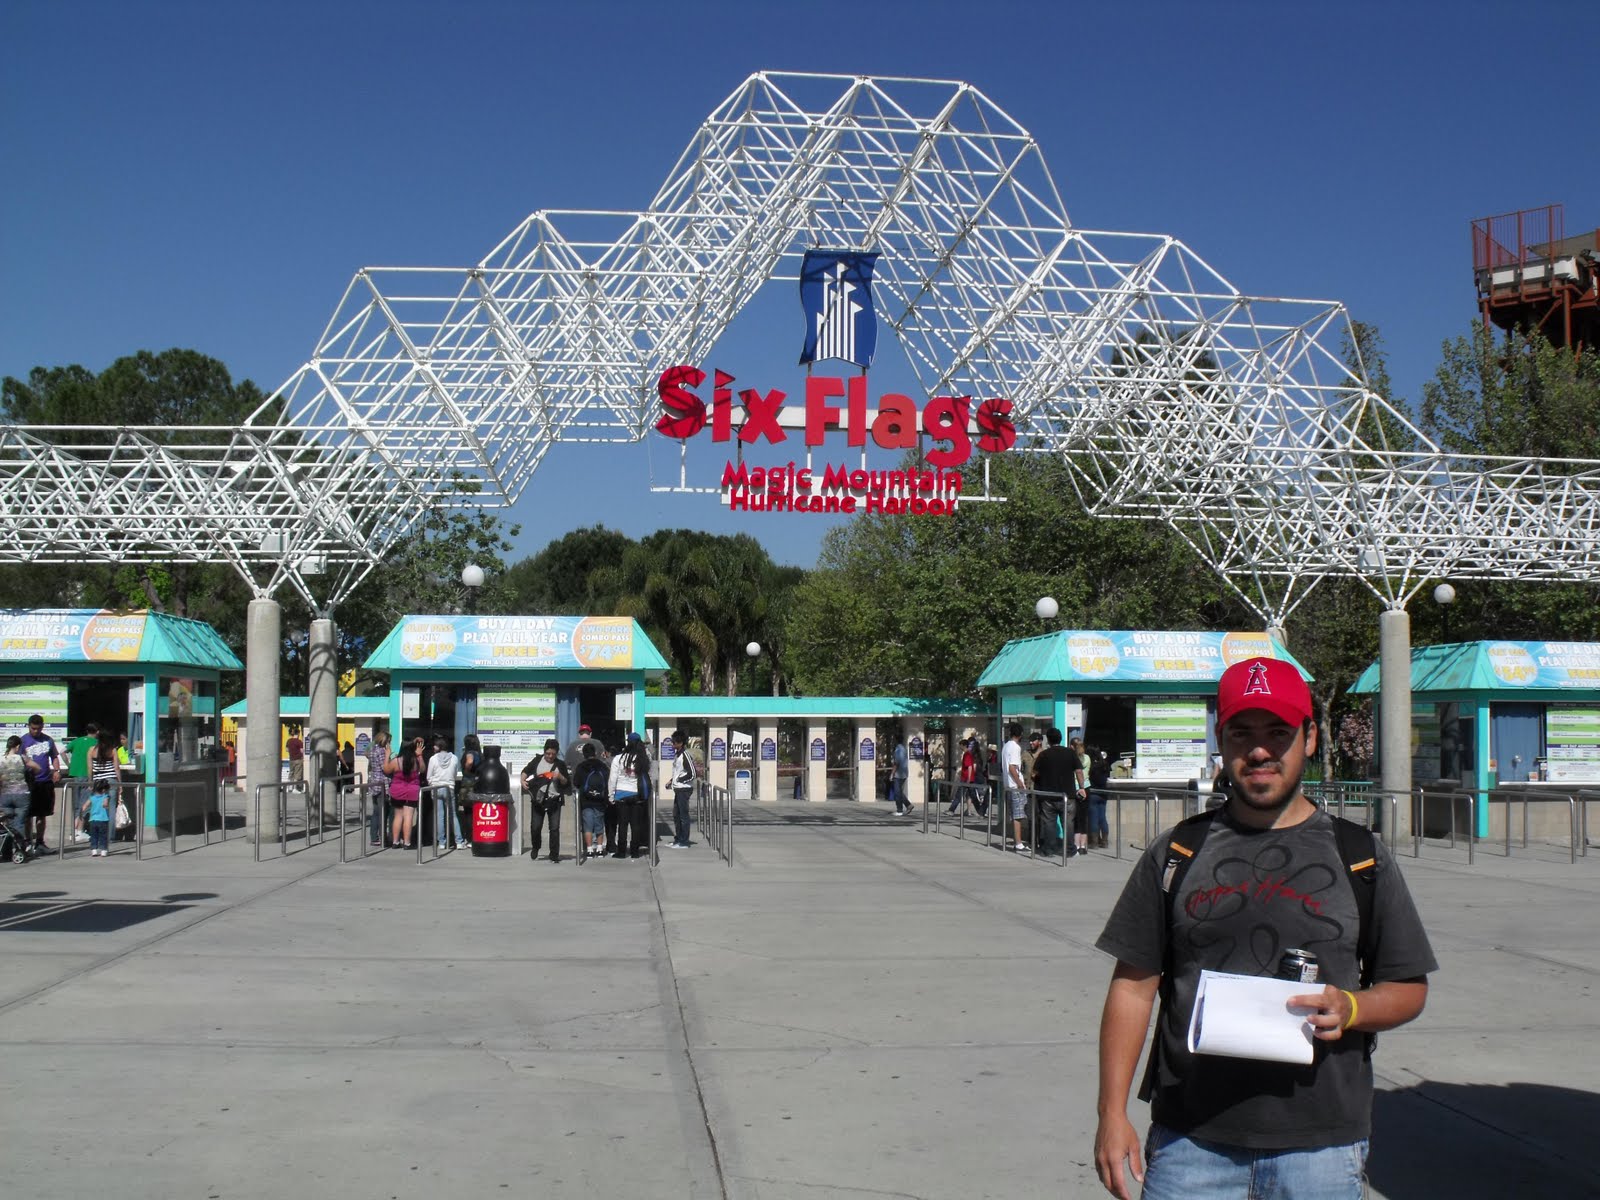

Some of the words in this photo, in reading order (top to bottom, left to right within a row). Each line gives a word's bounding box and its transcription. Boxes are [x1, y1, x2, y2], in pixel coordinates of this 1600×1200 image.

[655, 365, 787, 445] Six
[805, 376, 1017, 467] Flags
[721, 459, 813, 493] Magic
[822, 463, 963, 493] Mountain
[730, 489, 857, 514] Hurricane
[866, 490, 959, 516] Harbor
[478, 618, 507, 630] BUY
[511, 618, 522, 630] A
[526, 618, 555, 630] DAY
[44, 624, 80, 636] YEAR
[417, 633, 439, 641] ONLY
[463, 632, 497, 644] PLAY
[503, 632, 529, 644] ALL
[530, 632, 568, 644] YEAR
[1133, 634, 1159, 644] BUY
[1164, 634, 1174, 644] A
[1177, 634, 1201, 644] DAY
[2, 639, 48, 650] FREE
[1545, 644, 1568, 654] BUY
[493, 646, 539, 657] FREE
[1123, 646, 1153, 657] PLAY
[1159, 646, 1183, 657] ALL
[1185, 646, 1218, 657] YEAR
[1154, 660, 1196, 670] FREE
[1538, 656, 1566, 666] PLAY
[1243, 661, 1272, 697] A
